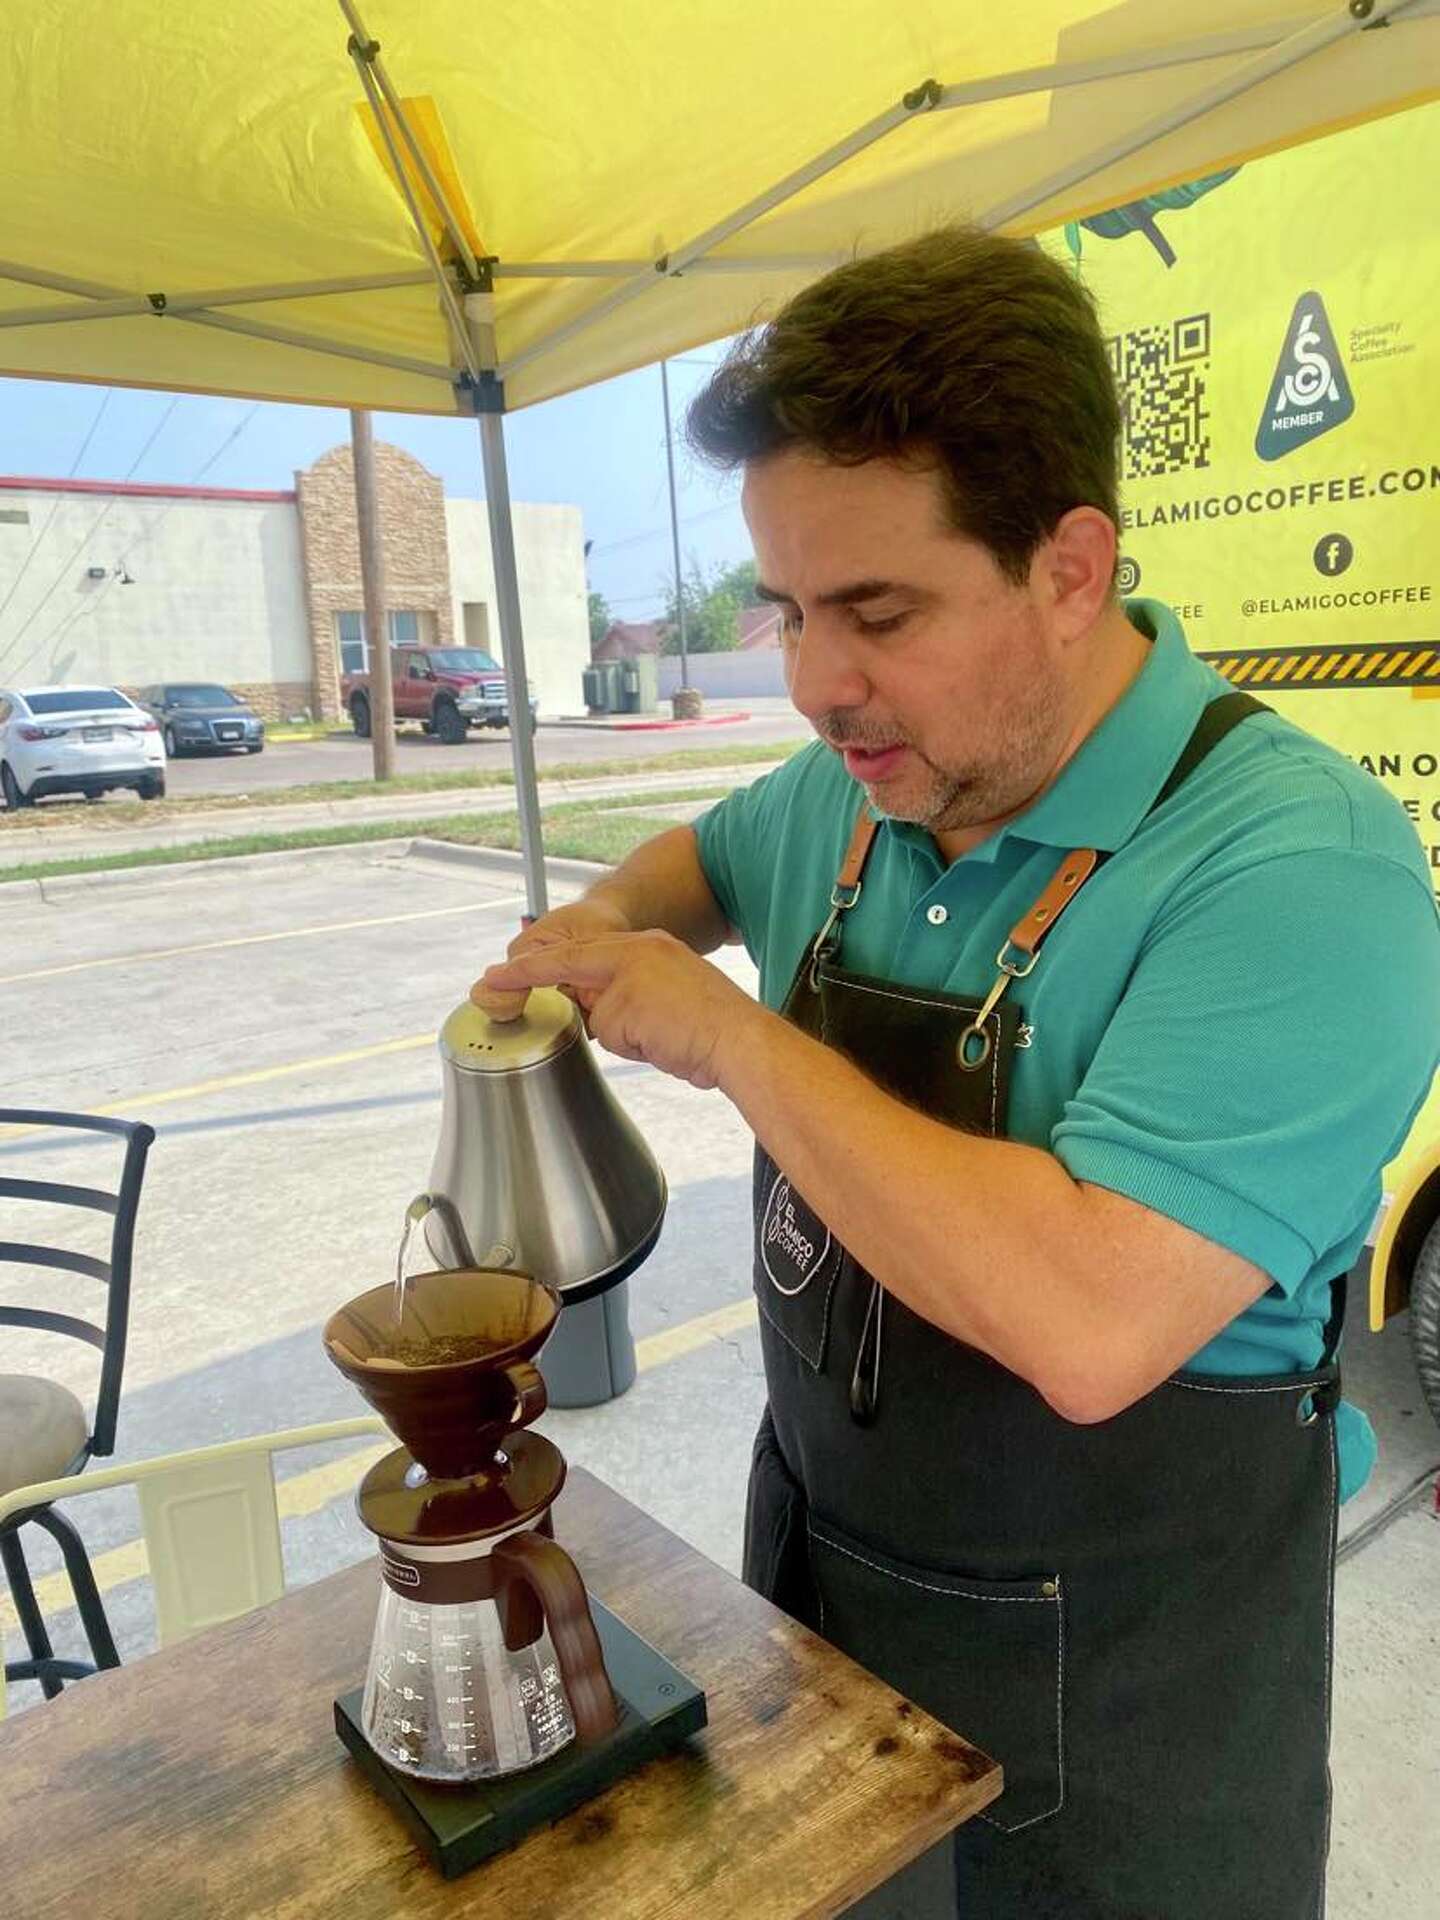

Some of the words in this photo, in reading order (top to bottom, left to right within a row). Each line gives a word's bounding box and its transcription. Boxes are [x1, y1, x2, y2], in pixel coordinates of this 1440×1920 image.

[1272, 411, 1324, 431] MEMBER
[1241, 586, 1431, 617] @ELAMIGOCOFFEE
[1358, 754, 1401, 777] AN
[777, 1232, 808, 1272] COFFEE
